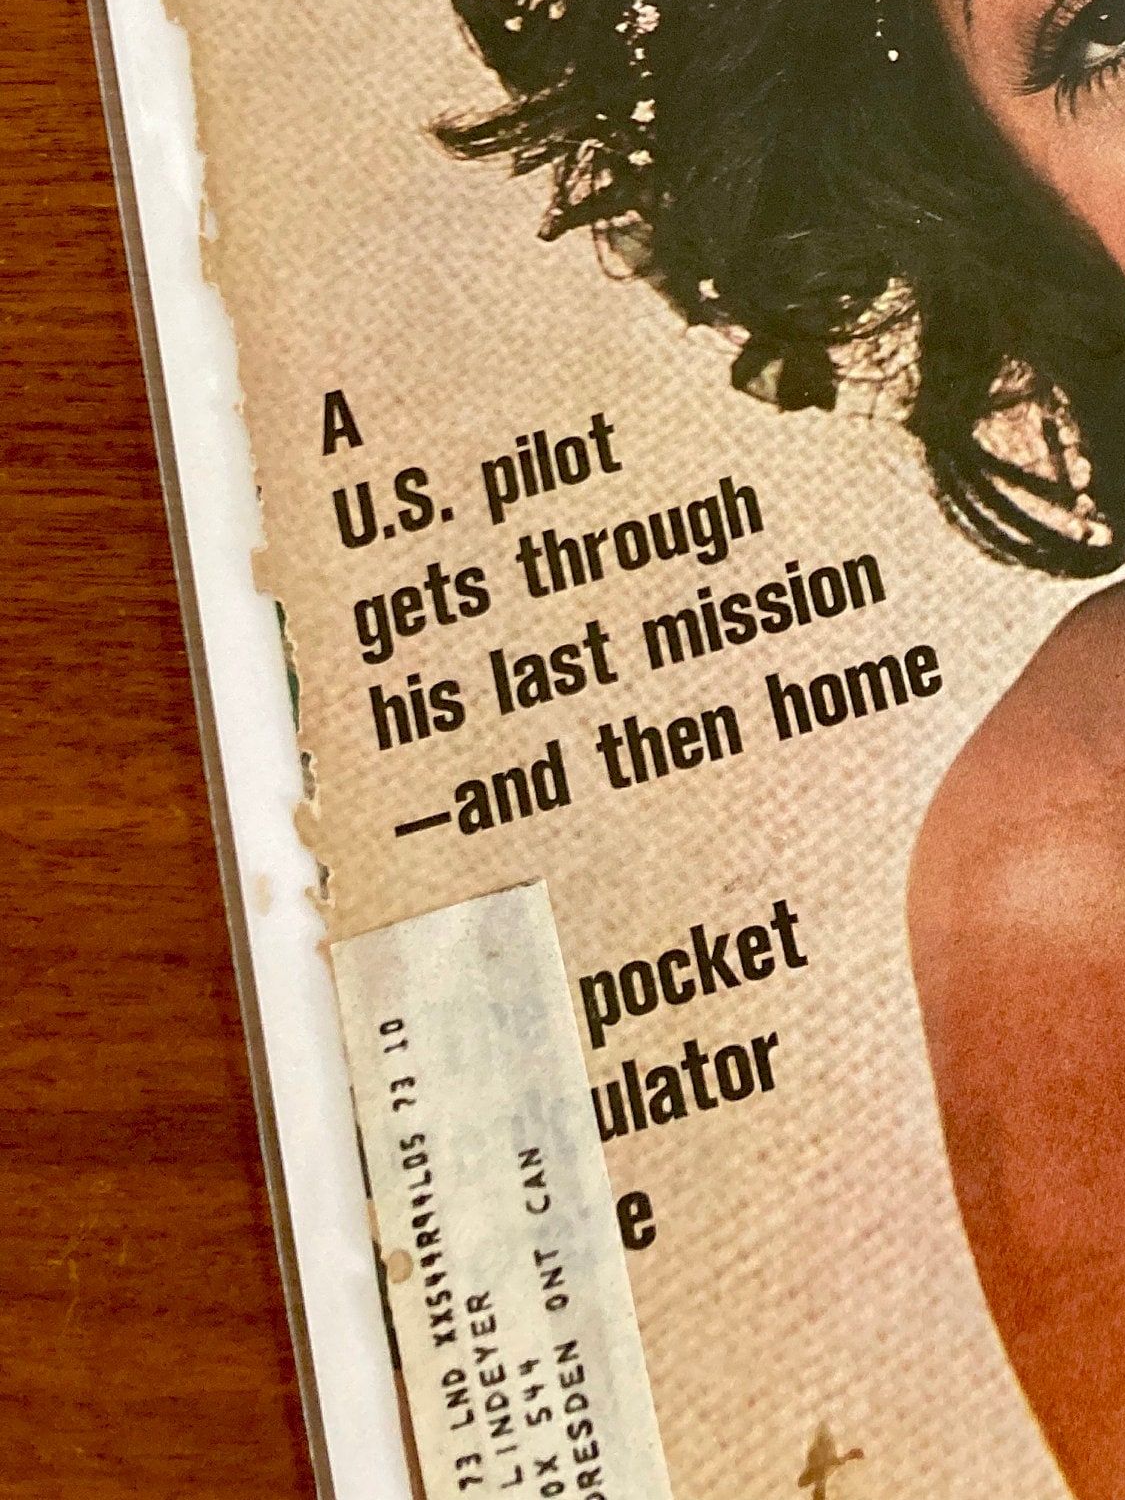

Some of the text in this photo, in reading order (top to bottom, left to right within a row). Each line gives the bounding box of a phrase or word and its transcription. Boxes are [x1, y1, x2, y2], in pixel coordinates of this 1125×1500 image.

[322, 389, 364, 457] A
[331, 412, 623, 550] U.S. pilot
[353, 475, 764, 665] gets through
[368, 554, 887, 751] his last mission
[597, 704, 744, 790] then
[764, 644, 943, 742] home
[578, 899, 809, 1050] pocket
[517, 1147, 552, 1215] CAN
[533, 1249, 570, 1312] ONT
[441, 1368, 475, 1431] LND
[465, 1290, 524, 1489] LINDEYER
[518, 1358, 553, 1428] 544
[455, 1452, 484, 1492] 73
